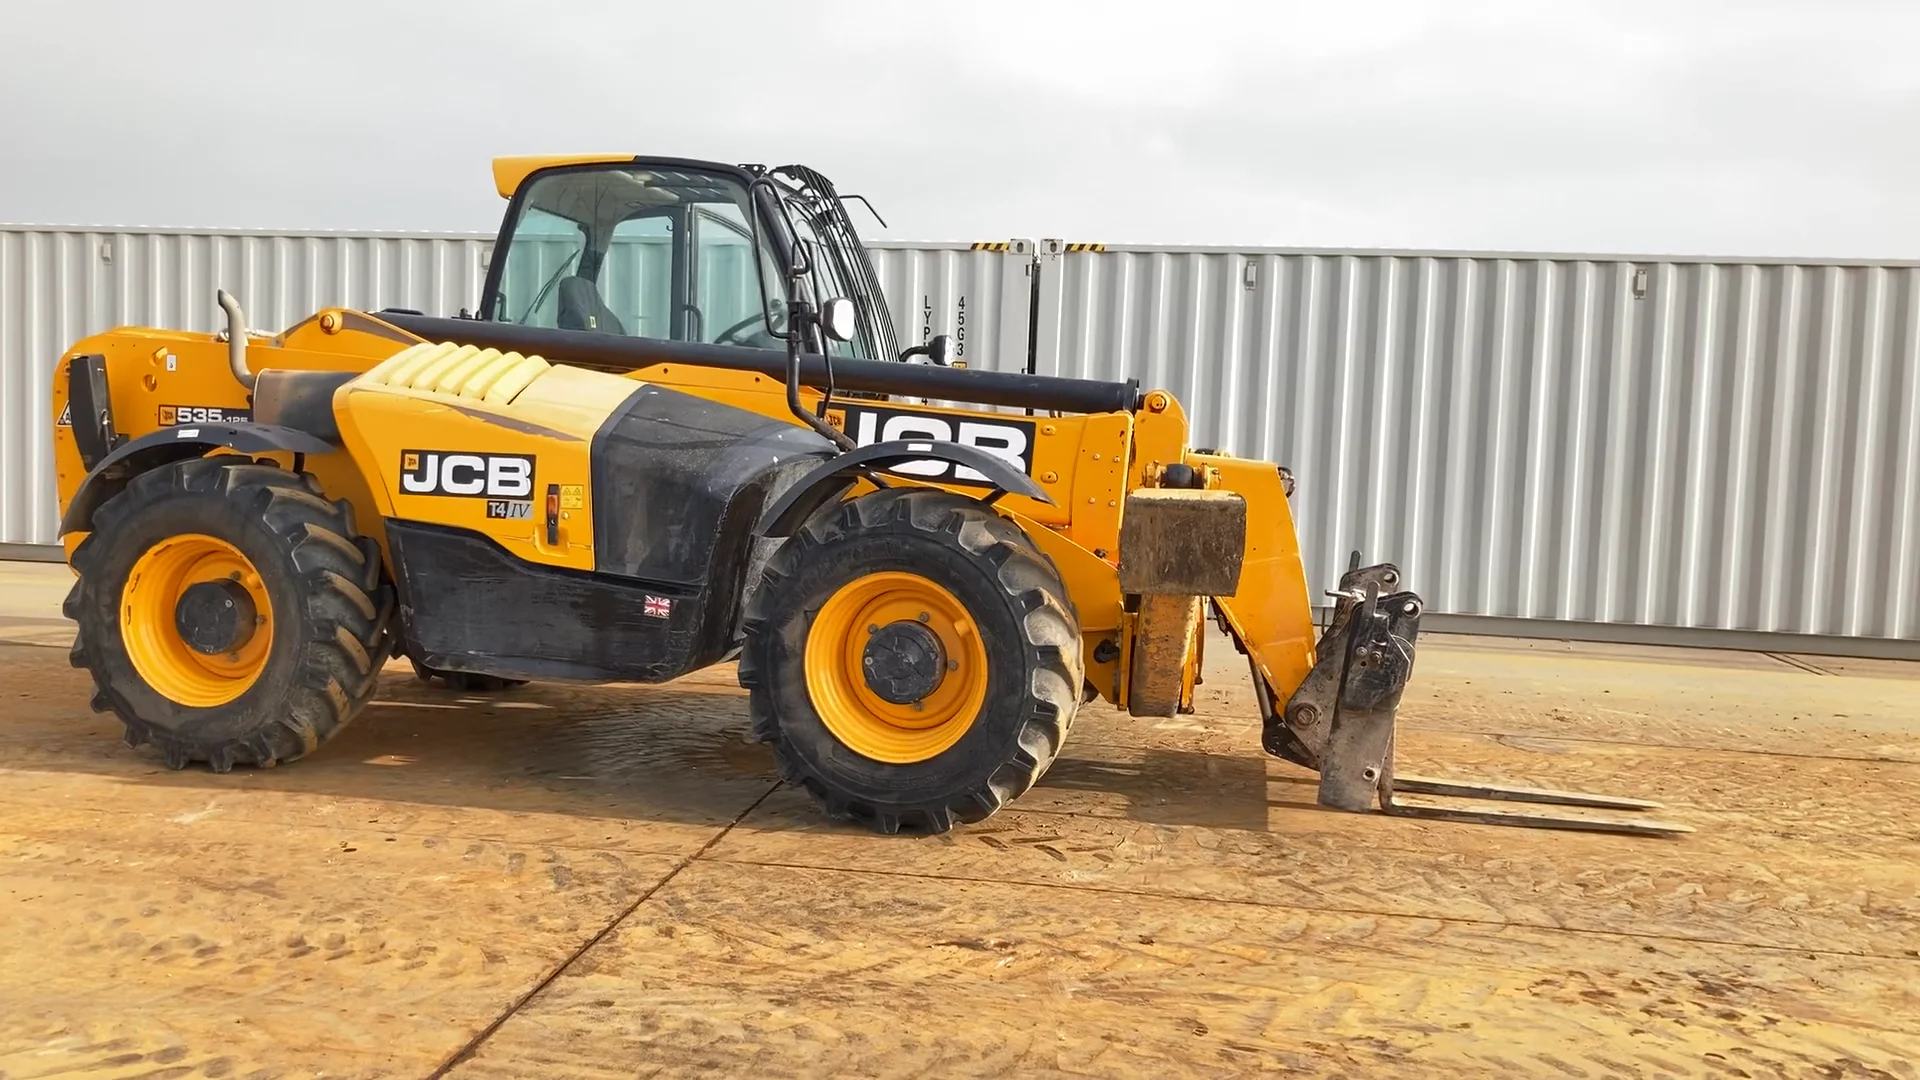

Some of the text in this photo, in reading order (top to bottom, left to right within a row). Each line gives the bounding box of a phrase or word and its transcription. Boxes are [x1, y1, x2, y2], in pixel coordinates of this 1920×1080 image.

[924, 295, 932, 347] LYP
[957, 296, 965, 356] 45G3
[403, 454, 532, 497] JCB
